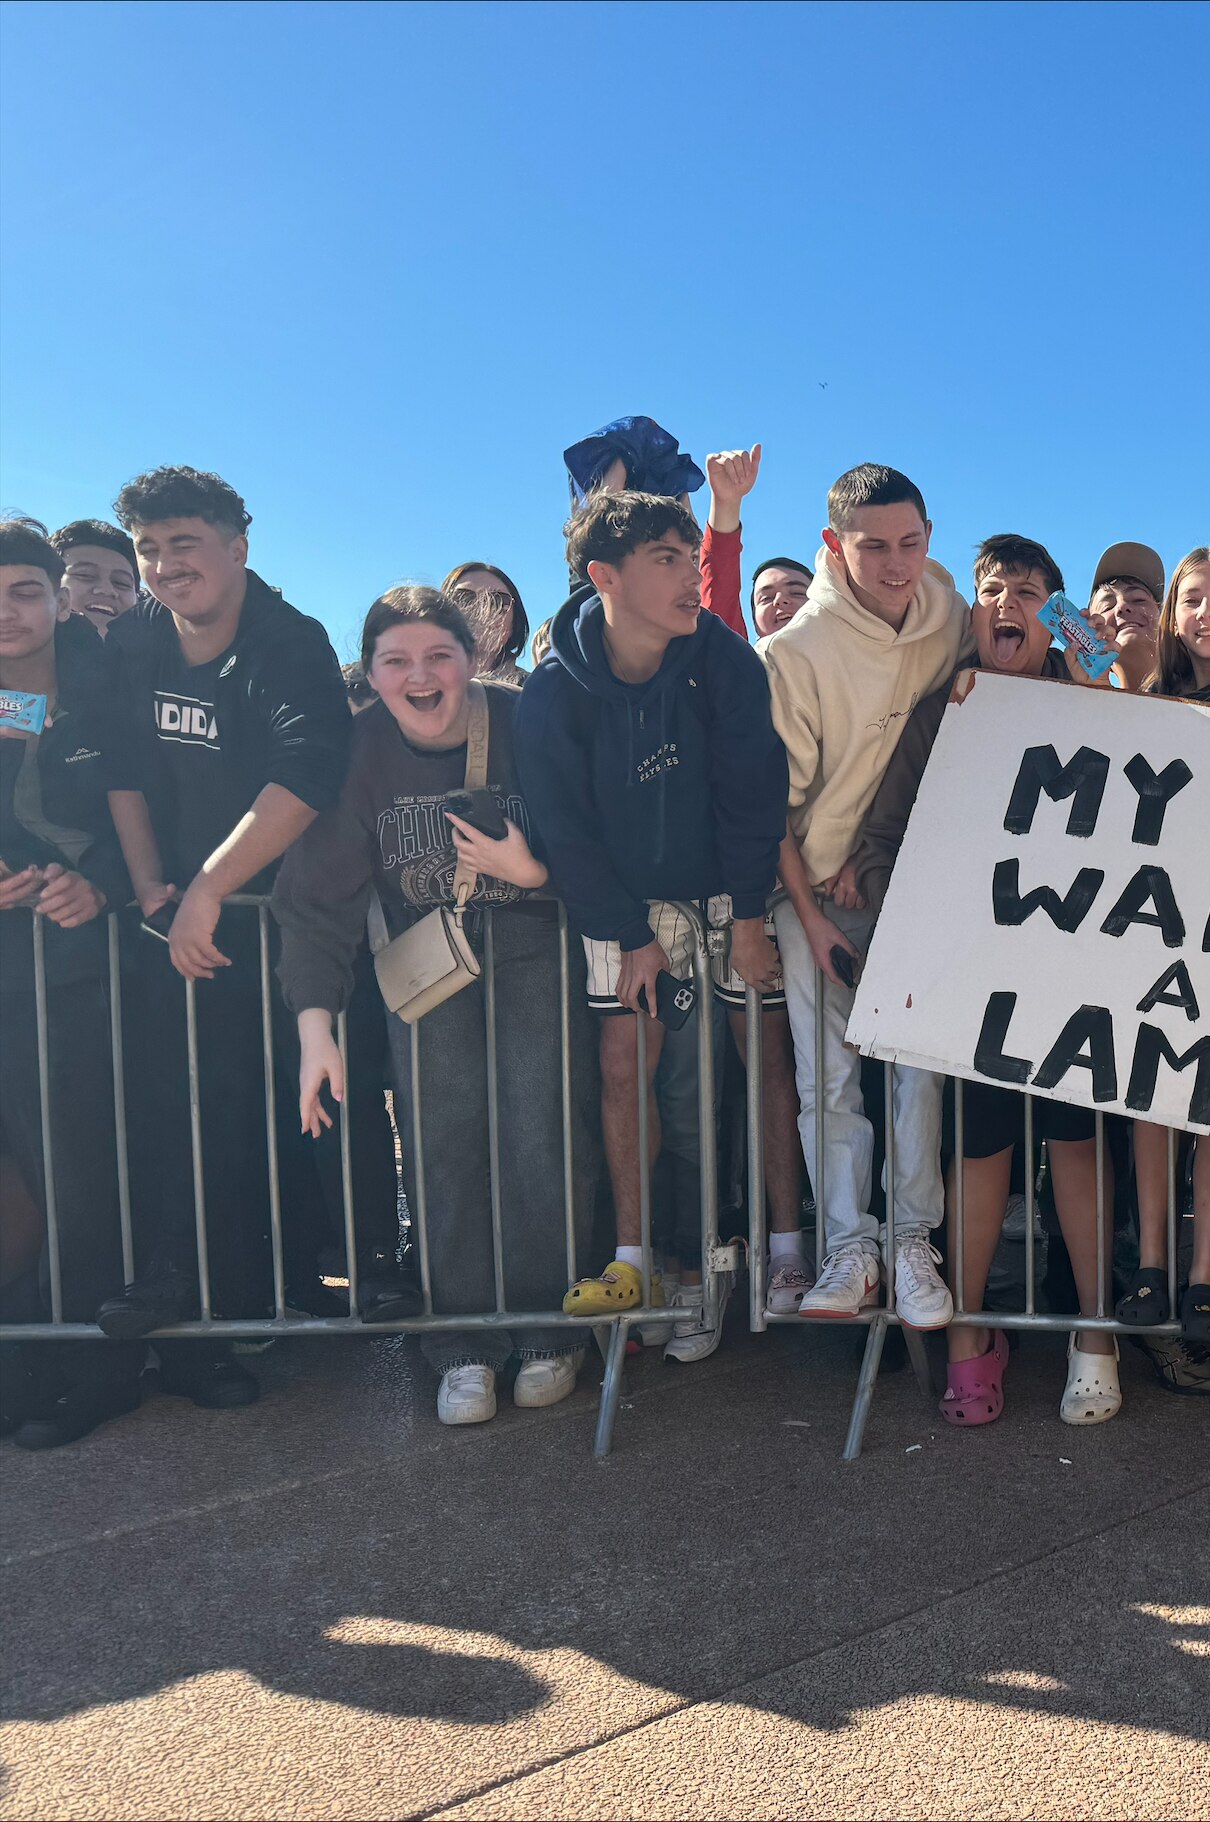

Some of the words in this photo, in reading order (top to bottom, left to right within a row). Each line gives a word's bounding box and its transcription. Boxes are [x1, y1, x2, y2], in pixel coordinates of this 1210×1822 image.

[1059, 615, 1097, 655] FEASTABLES
[639, 757, 679, 782] ELYSES
[1004, 744, 1194, 846] MY
[1136, 959, 1200, 1022] A
